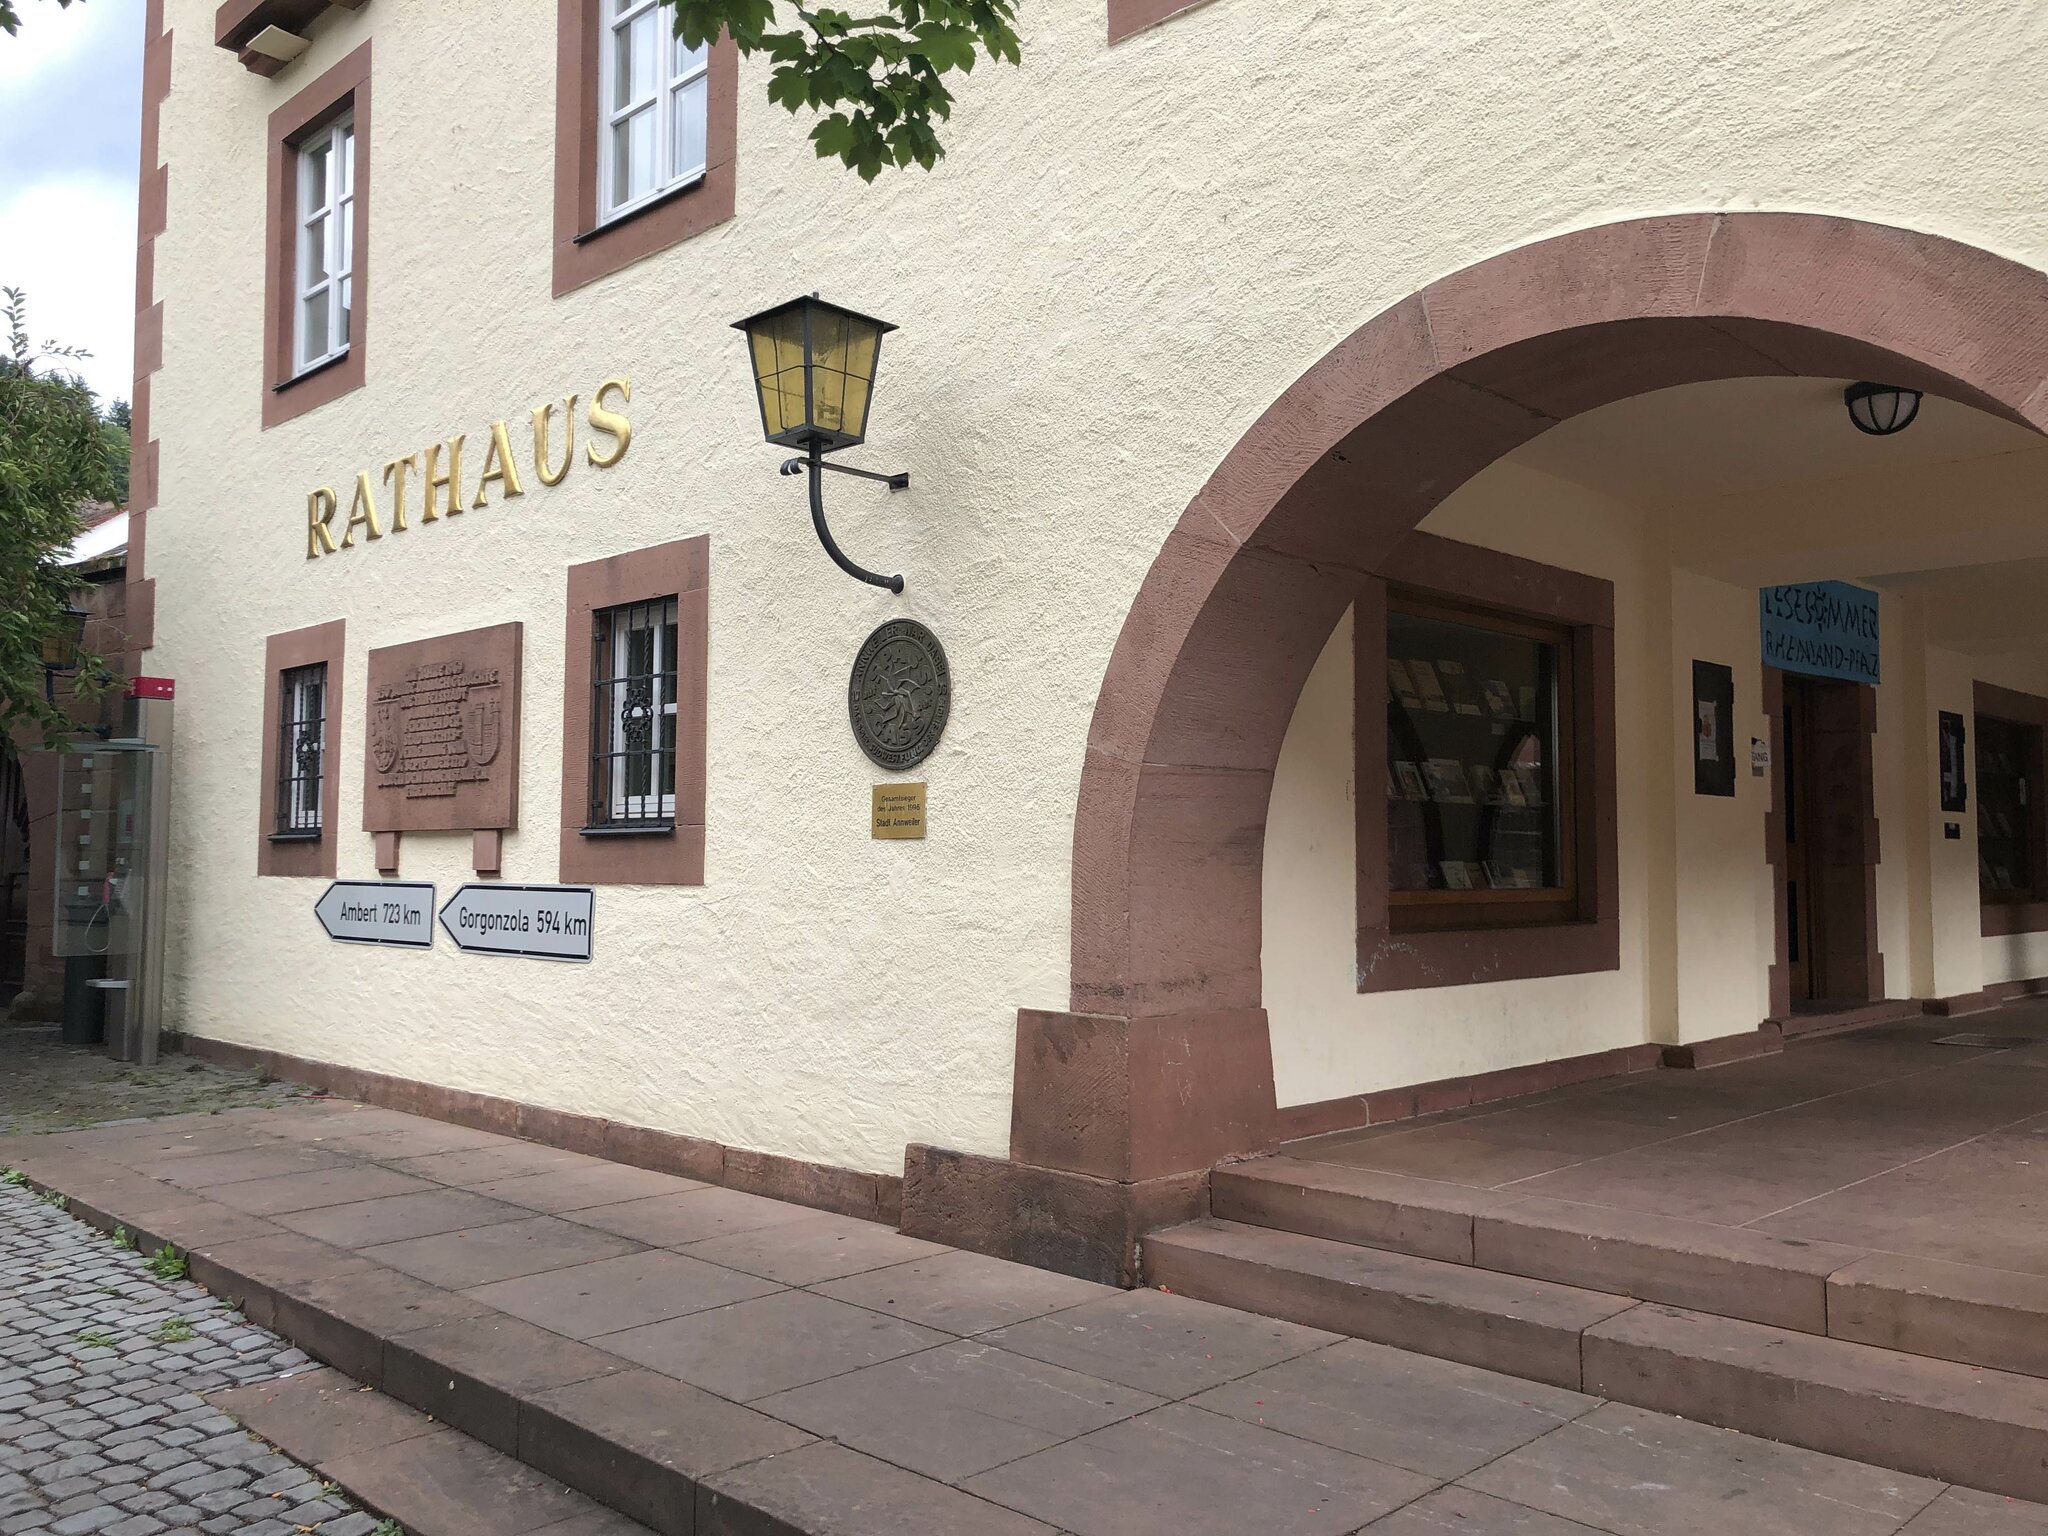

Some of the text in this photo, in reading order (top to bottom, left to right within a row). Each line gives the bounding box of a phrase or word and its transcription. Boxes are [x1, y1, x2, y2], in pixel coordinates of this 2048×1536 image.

[307, 374, 632, 560] RATHAUS
[876, 817, 920, 827] Stadt Annweiler
[340, 901, 421, 926] Ambert 723 km
[459, 906, 587, 936] Gorgonzola 594 km
